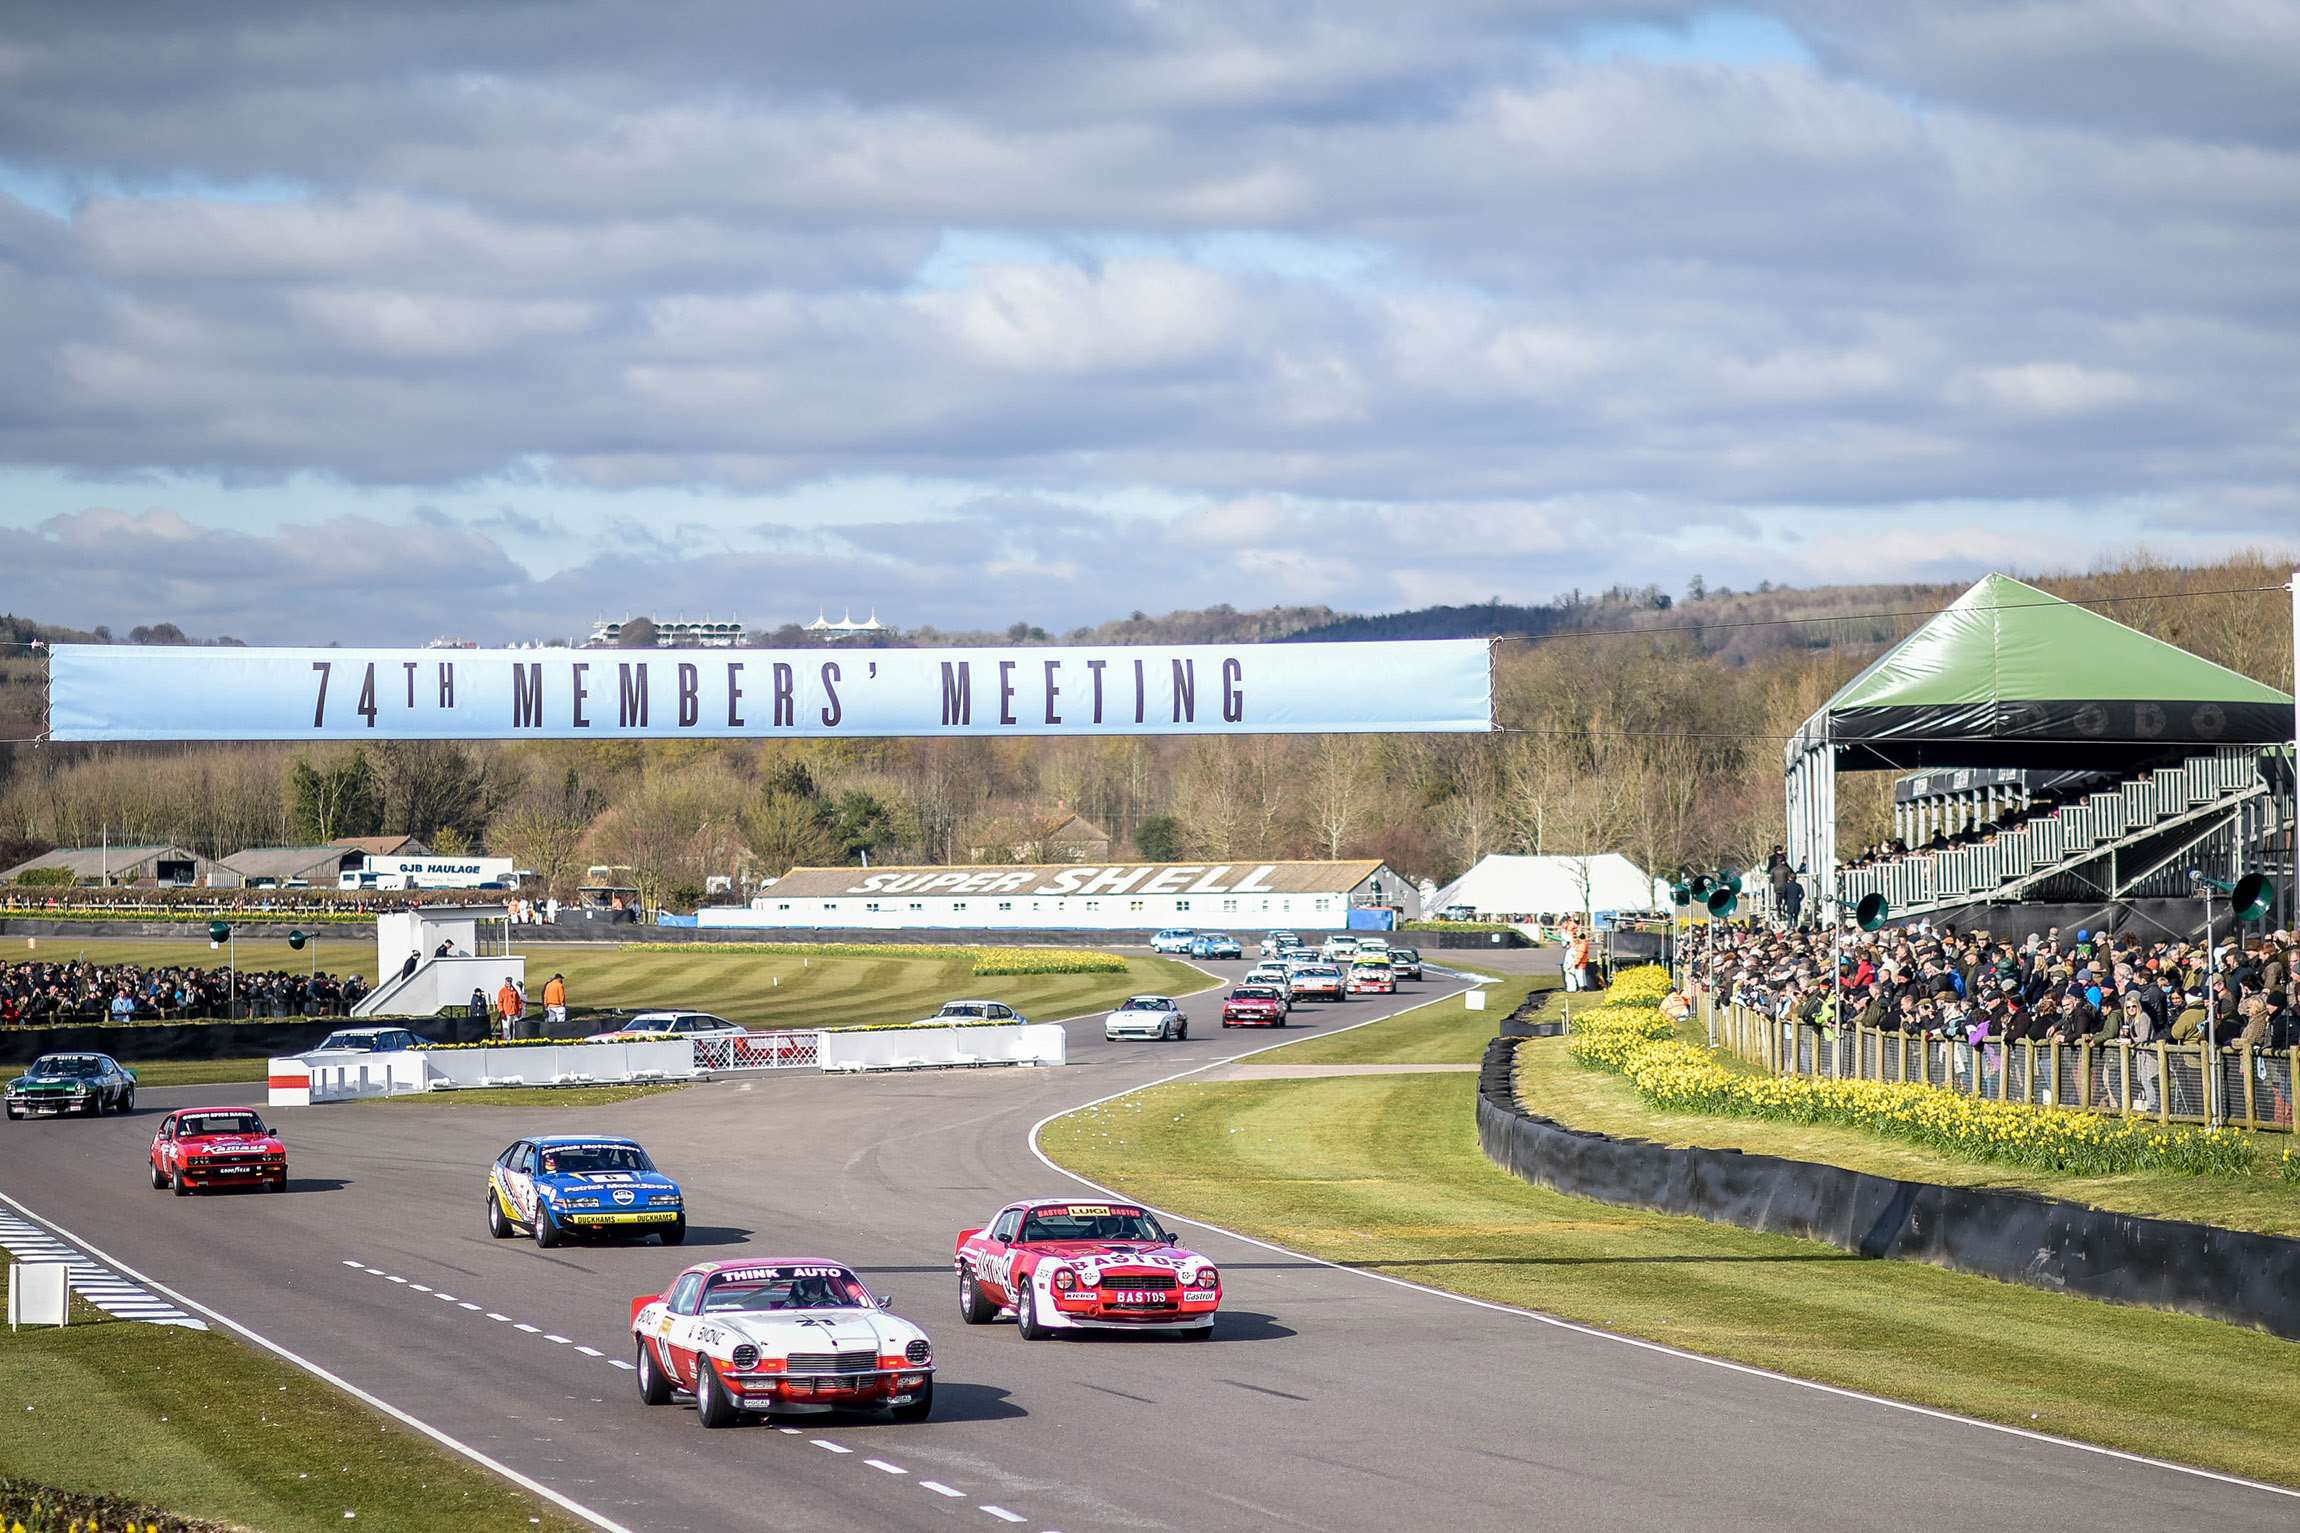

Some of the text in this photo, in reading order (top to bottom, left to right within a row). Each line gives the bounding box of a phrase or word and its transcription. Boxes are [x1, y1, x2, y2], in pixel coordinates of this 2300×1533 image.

[312, 657, 1243, 728] 74TH MEMBERS' MEETING
[400, 864, 481, 874] GJB HAULAGE
[847, 864, 1278, 896] SUPER SHELL
[1037, 1208, 1068, 1217] BASTOS
[1110, 1208, 1141, 1217] BASTOS
[577, 1213, 673, 1224] DUCKHAMS DUCKHAMS
[1069, 1254, 1187, 1271] BASTOS
[722, 1267, 841, 1281] THINK AUTO
[1116, 1292, 1167, 1303] BASTOS
[1185, 1293, 1213, 1301] Castrol
